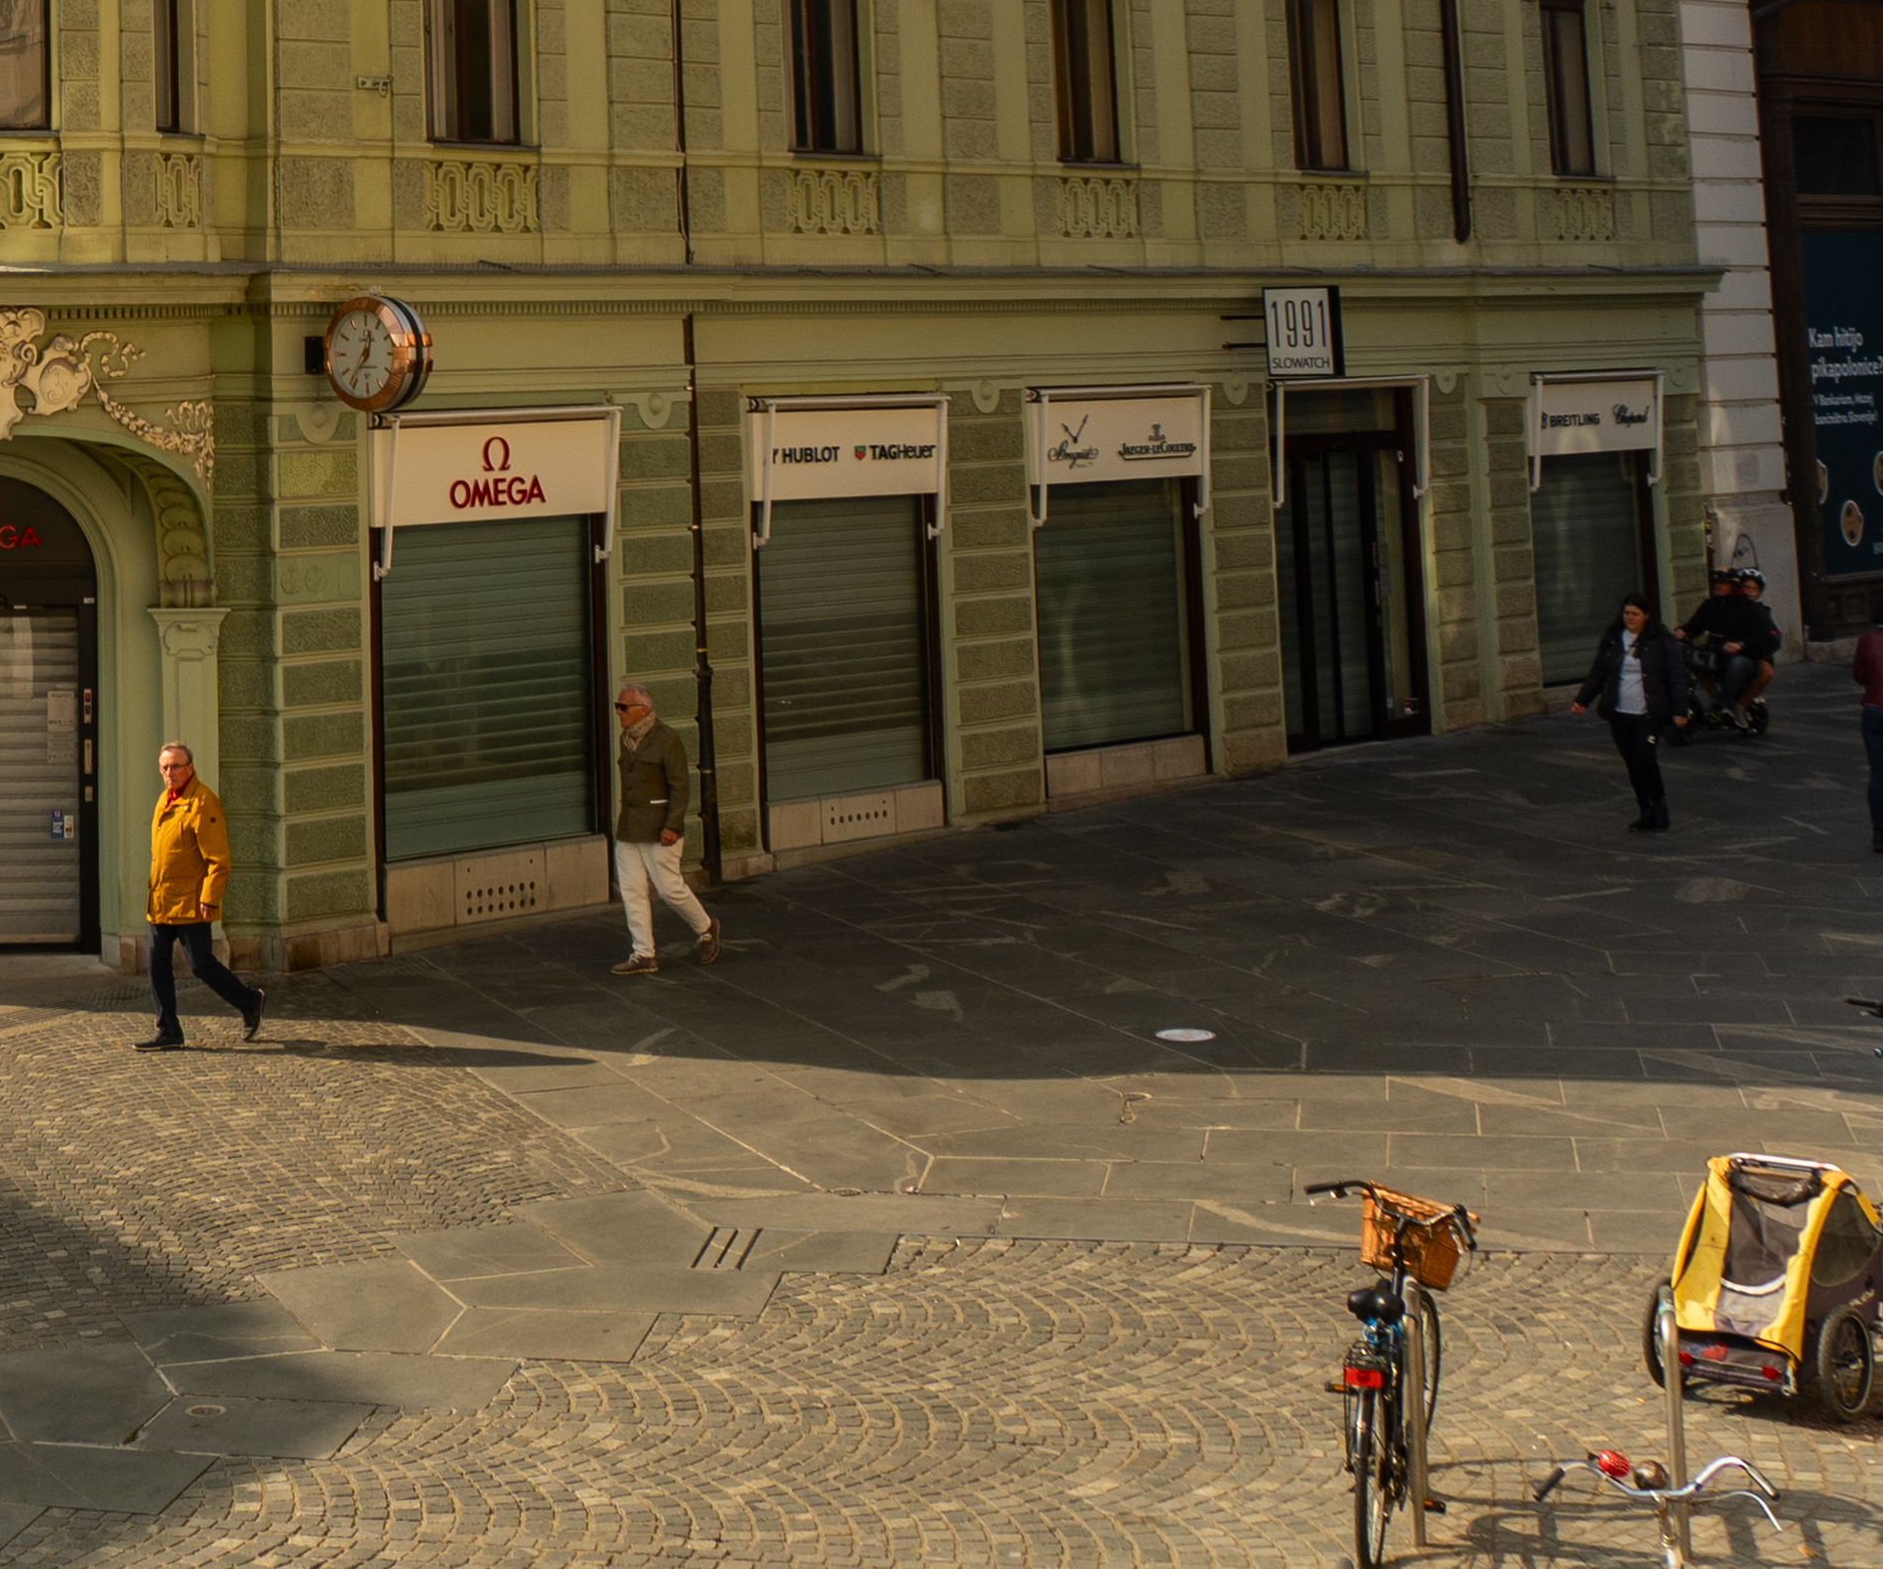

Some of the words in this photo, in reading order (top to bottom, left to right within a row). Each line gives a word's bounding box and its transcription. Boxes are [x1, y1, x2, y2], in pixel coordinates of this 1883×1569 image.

[1271, 299, 1326, 348] 1991
[1808, 327, 1833, 348] Kam
[1833, 325, 1863, 352] hitijo
[1272, 356, 1330, 369] SLOWATCH
[1549, 412, 1601, 428] BREITLING
[781, 445, 840, 464] HUBLOT
[449, 474, 547, 509] OMEGA
